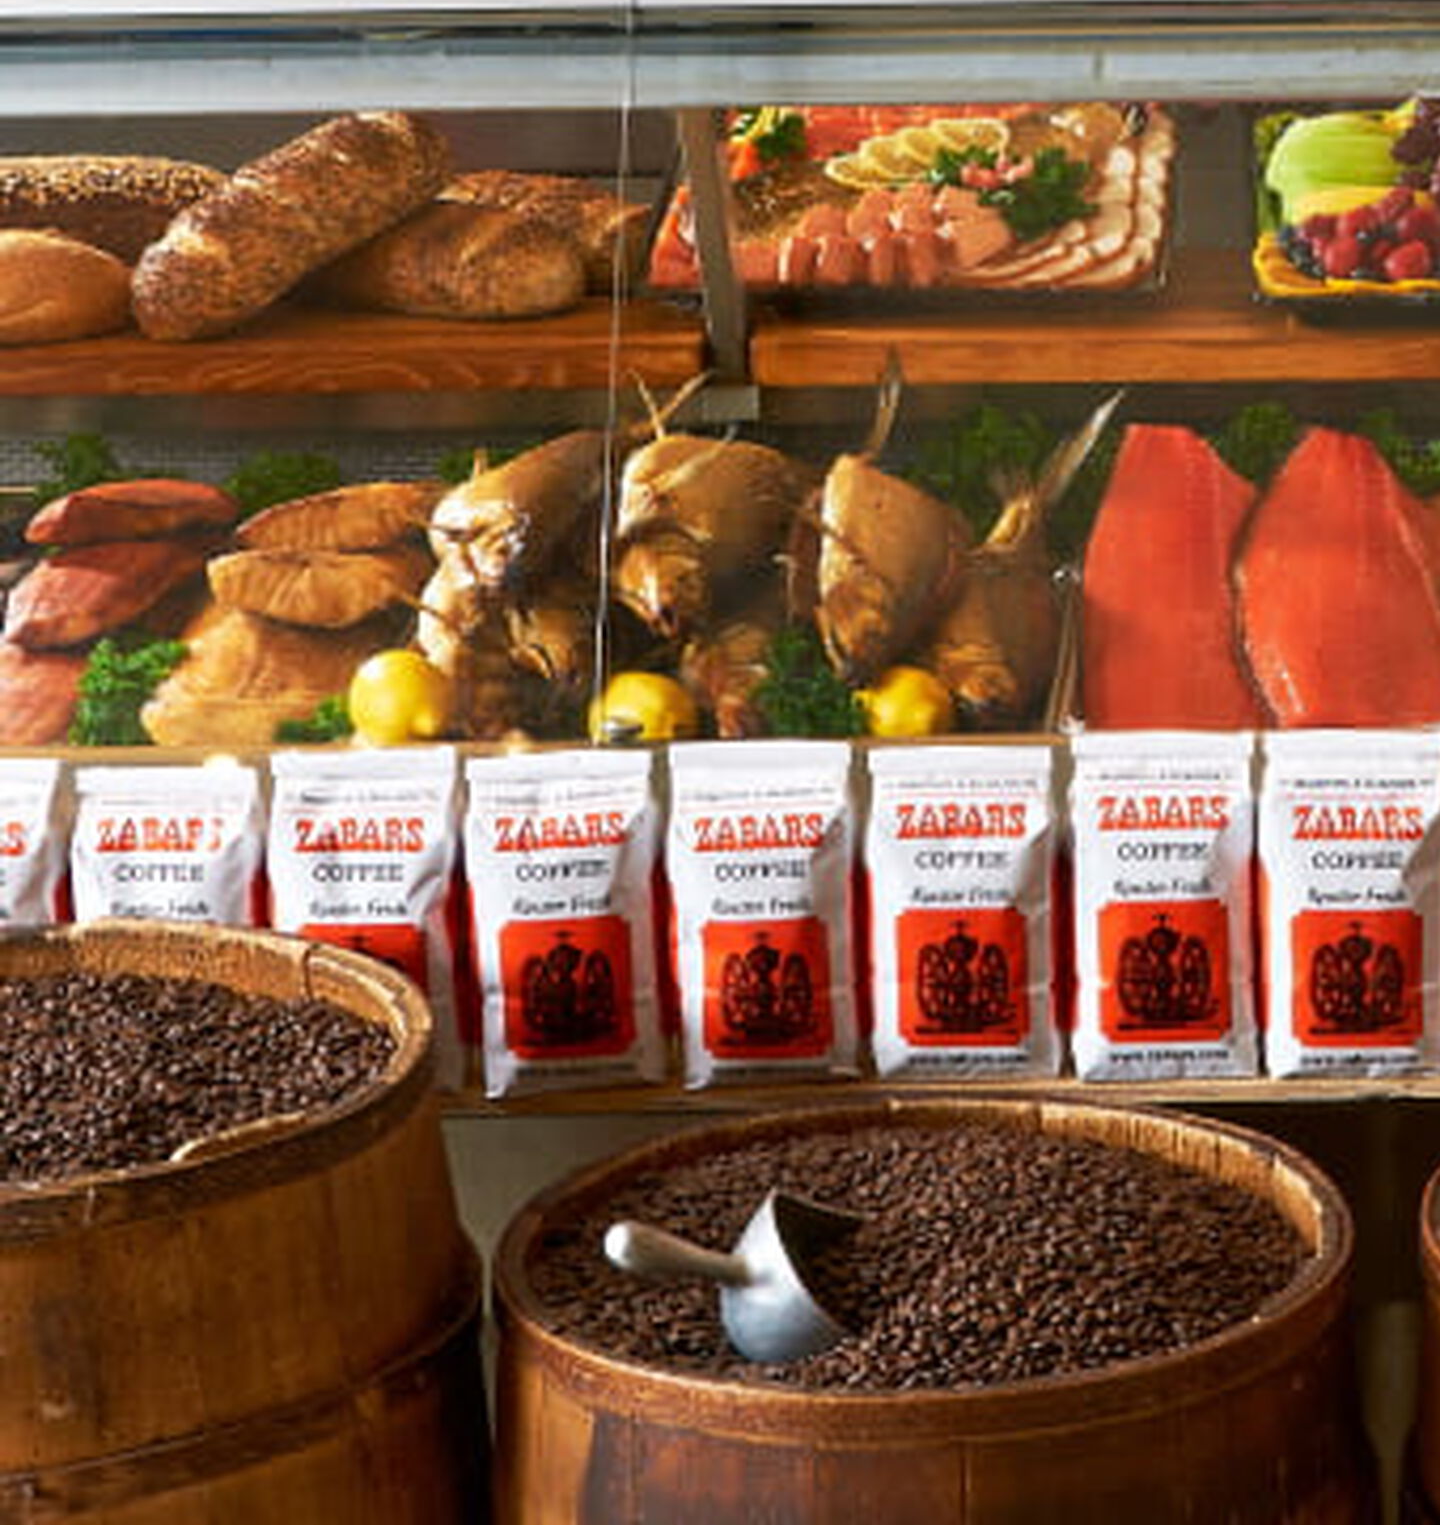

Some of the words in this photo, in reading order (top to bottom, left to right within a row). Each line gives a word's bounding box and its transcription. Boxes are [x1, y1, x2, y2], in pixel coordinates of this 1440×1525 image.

[896, 803, 1028, 839] ZABARS
[1098, 795, 1231, 831] ZABARS
[1292, 804, 1424, 841] ZABARS
[293, 817, 426, 853] ZABARS
[494, 812, 628, 852] ZABARS
[694, 812, 825, 852] ZABARS
